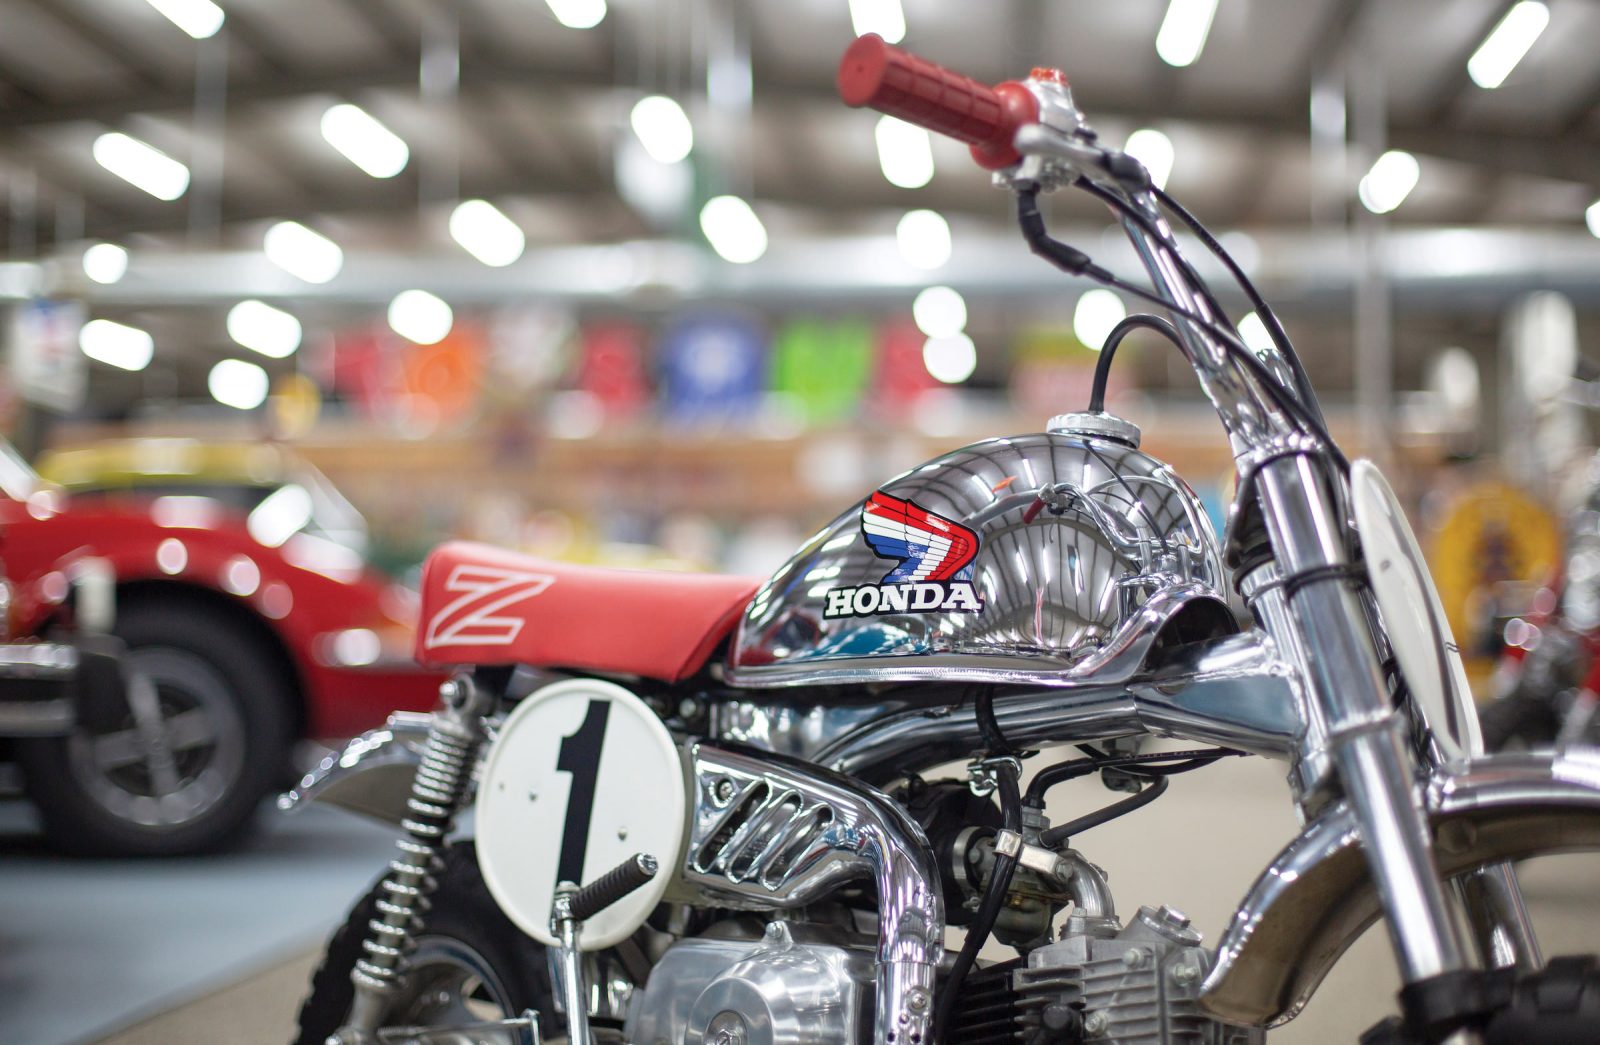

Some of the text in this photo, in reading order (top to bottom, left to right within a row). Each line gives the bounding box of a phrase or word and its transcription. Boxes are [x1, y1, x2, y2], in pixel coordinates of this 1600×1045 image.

[425, 564, 556, 649] Z
[825, 583, 982, 617] HONDA
[549, 699, 612, 930] 1
